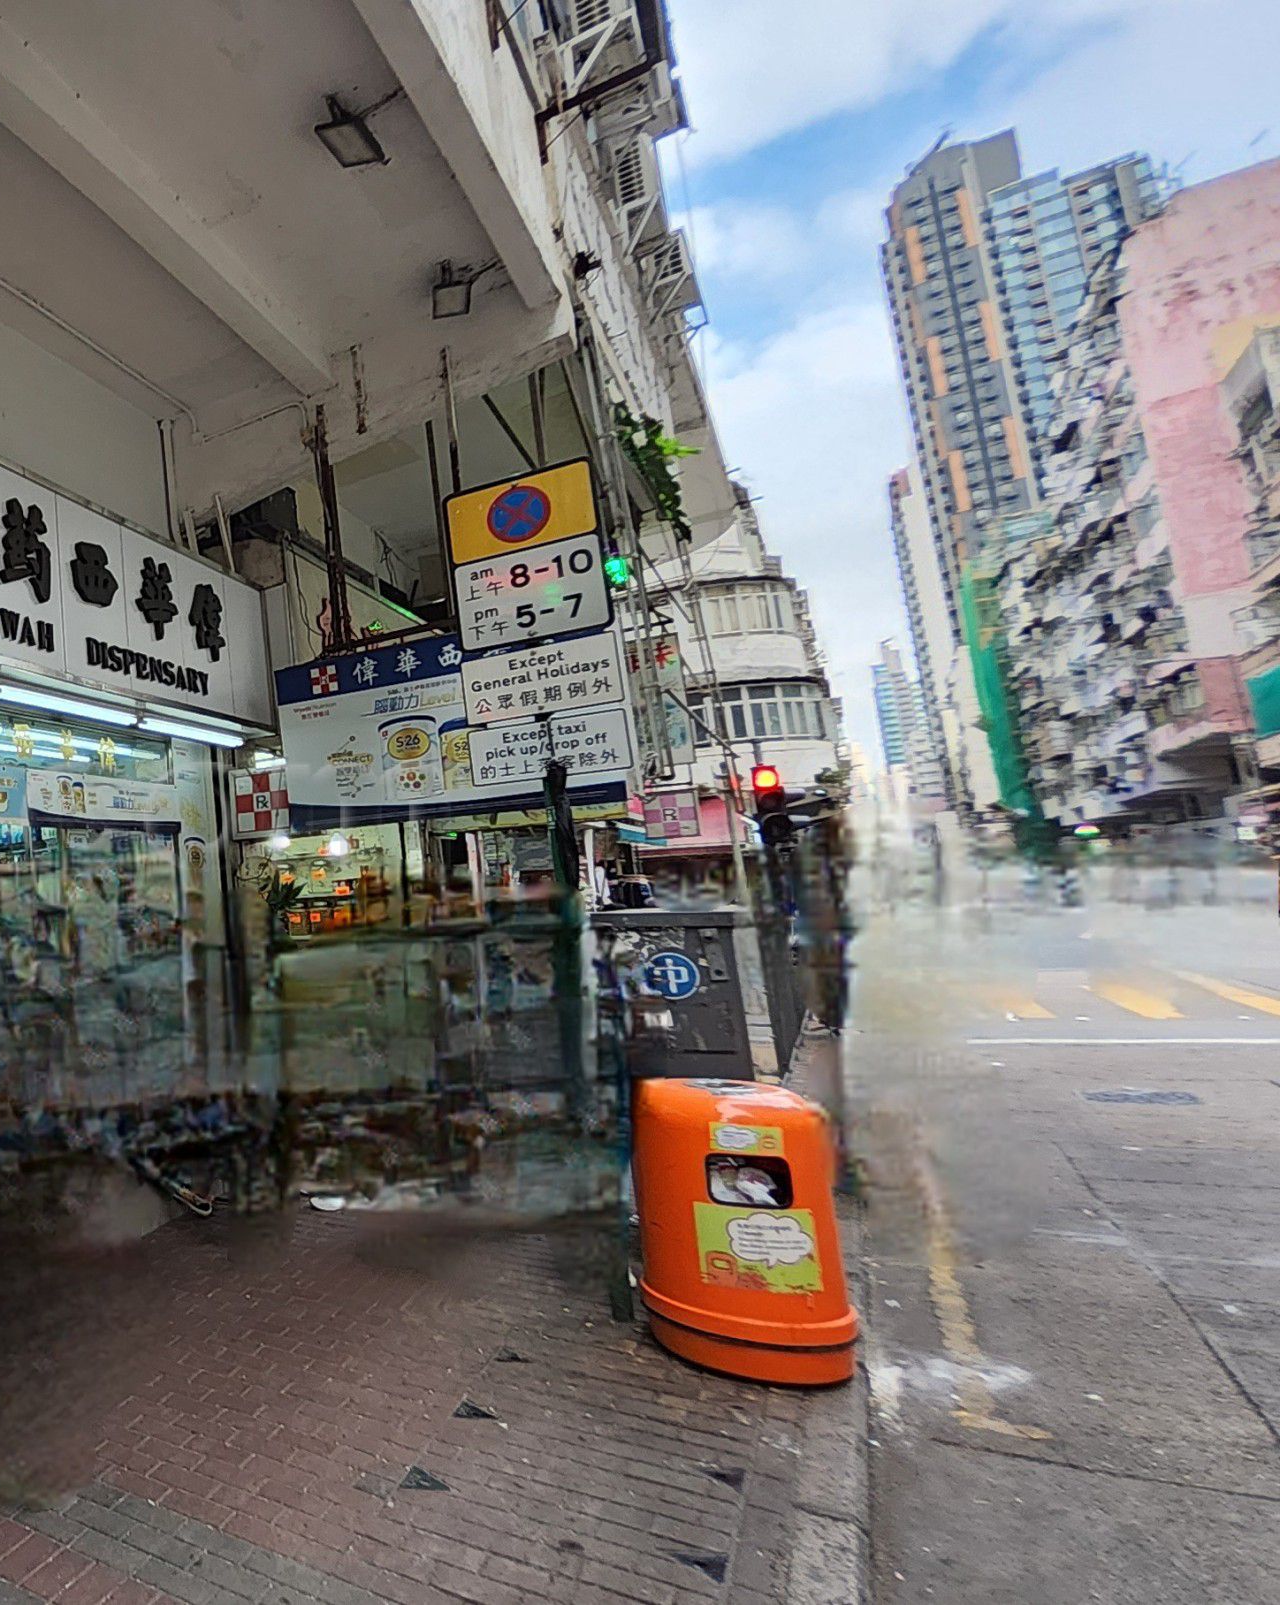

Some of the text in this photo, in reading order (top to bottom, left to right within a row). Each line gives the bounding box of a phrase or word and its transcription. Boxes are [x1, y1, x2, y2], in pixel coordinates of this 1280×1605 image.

[470, 567, 494, 581] am
[509, 549, 593, 588] 8-10
[465, 581, 504, 602] 上午
[474, 606, 499, 623] pm
[468, 620, 510, 641] 下午
[85, 637, 209, 696] DISPENSARY
[508, 650, 565, 671] Except
[471, 671, 532, 692] General
[537, 658, 610, 681] Holidays
[474, 676, 613, 715] 公眾假期例外
[557, 720, 587, 735] taxi
[486, 745, 516, 762] pick
[585, 732, 608, 746] off
